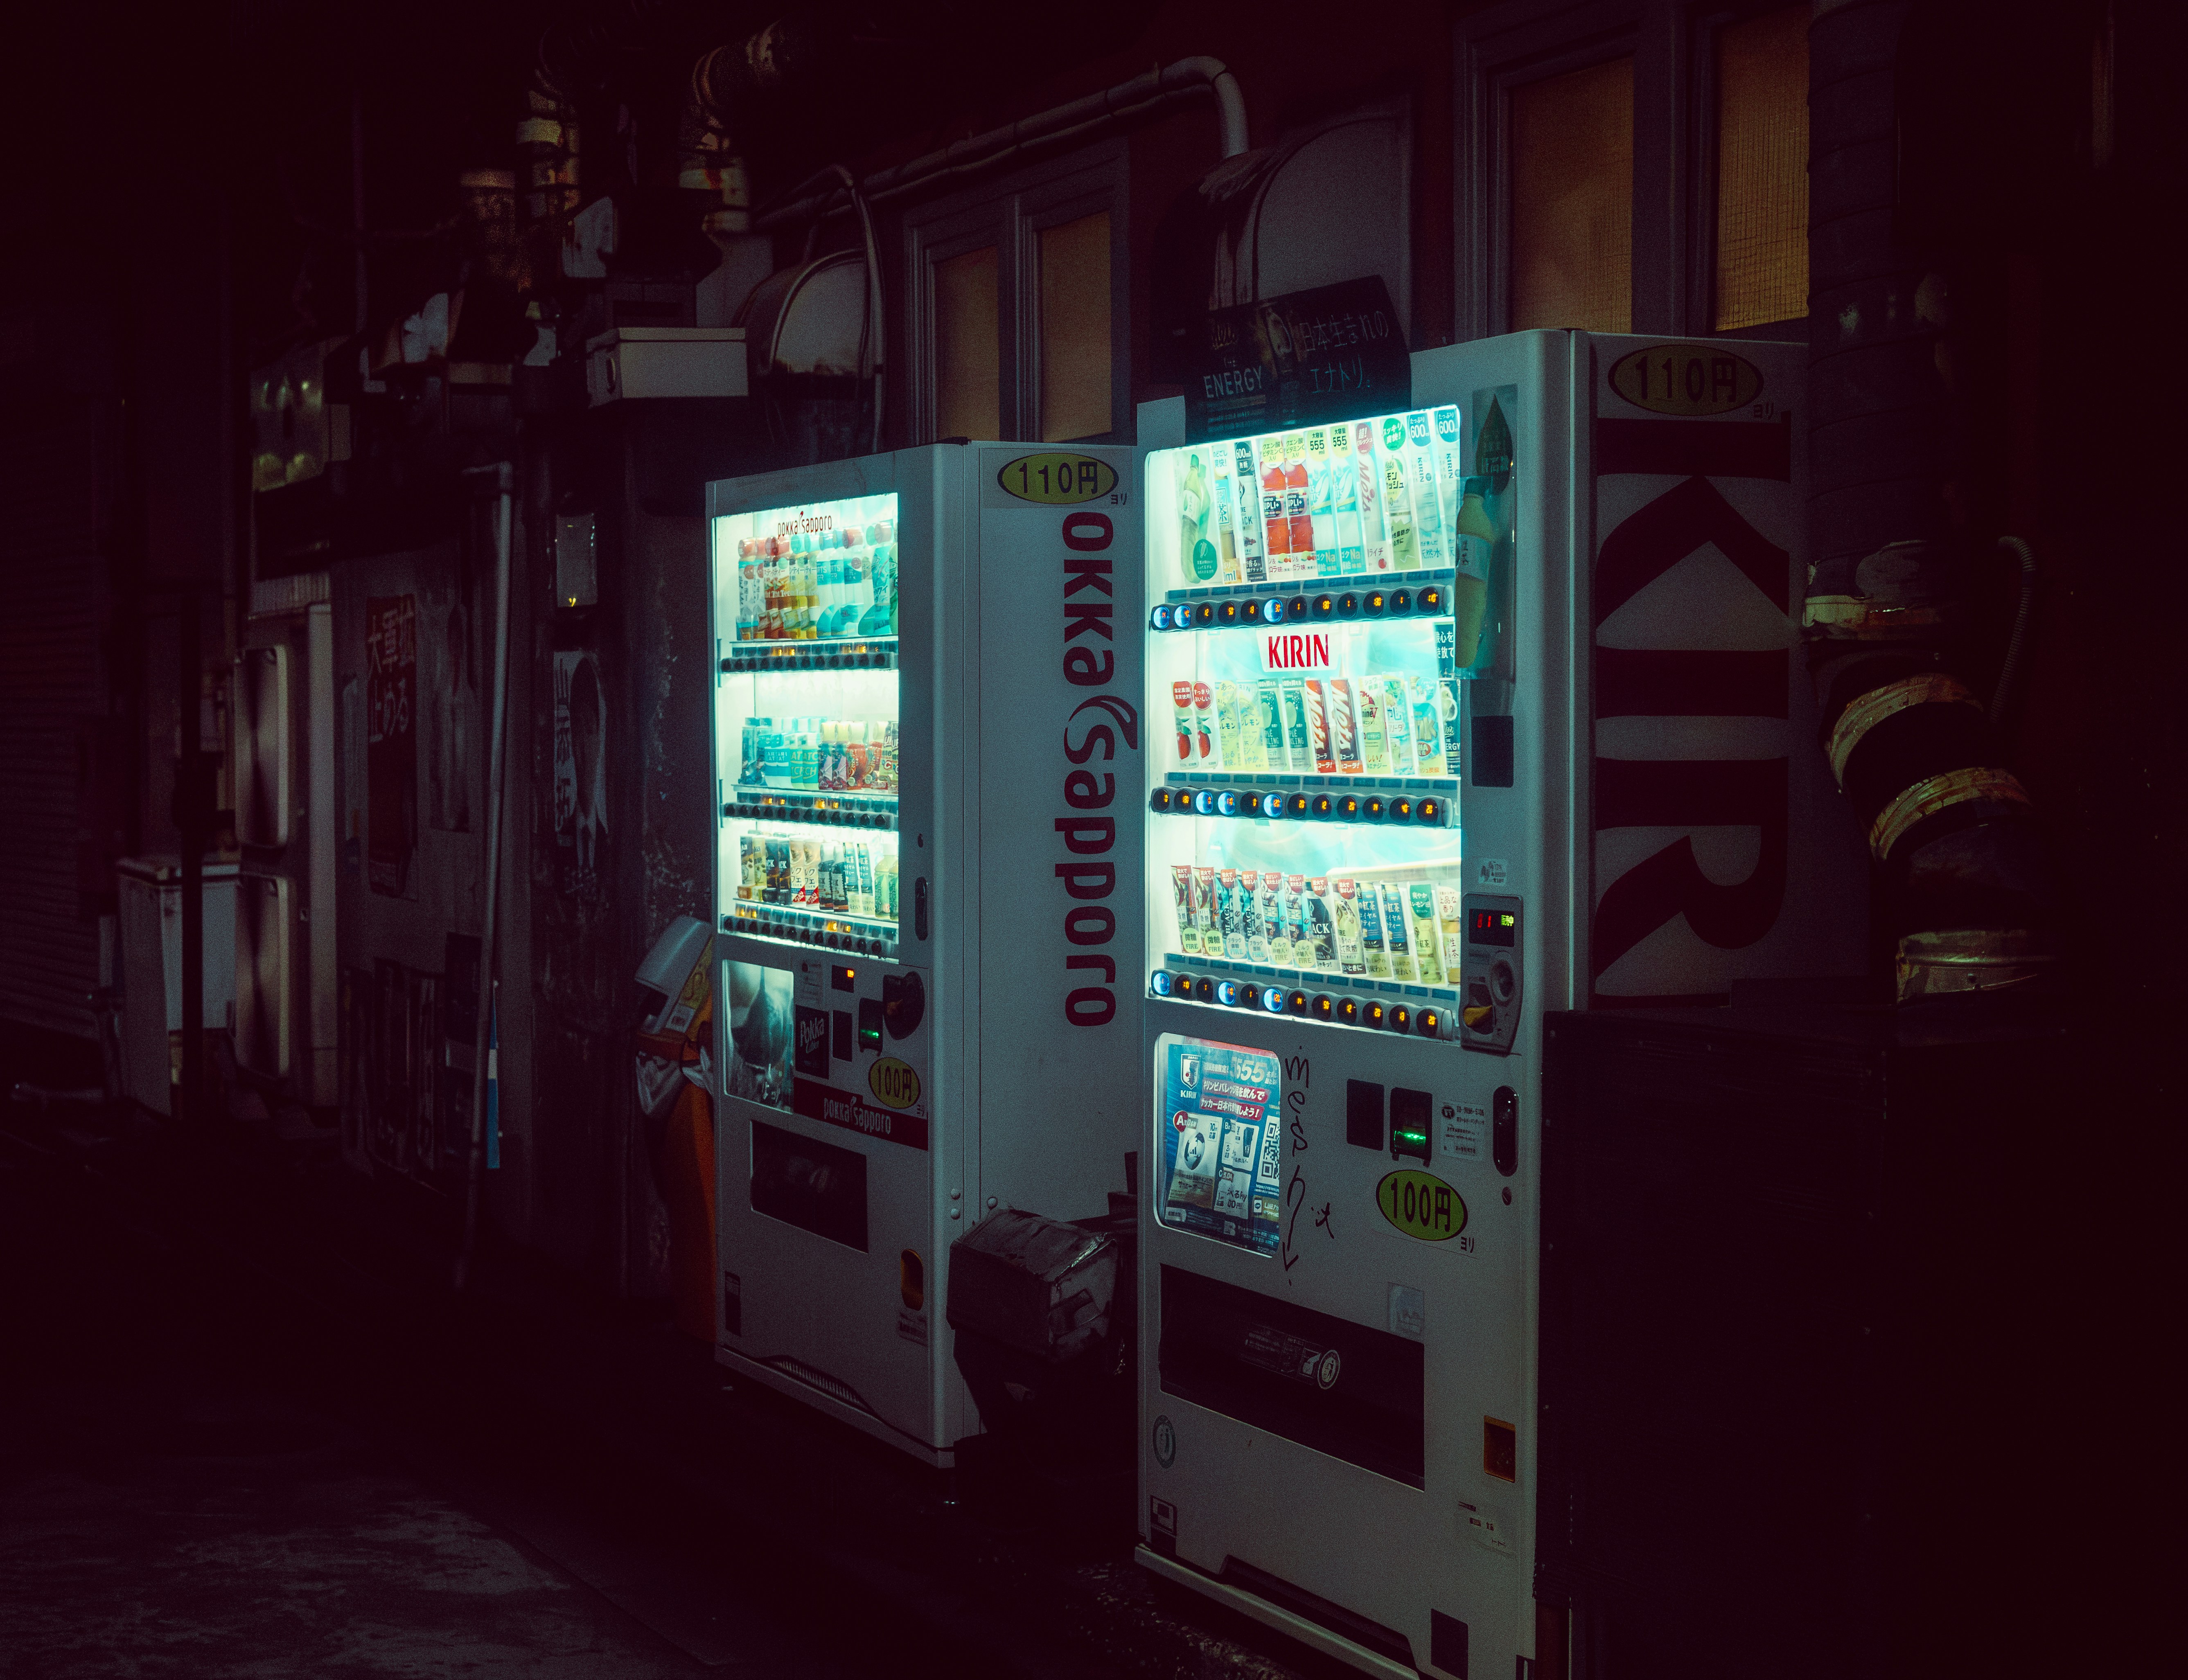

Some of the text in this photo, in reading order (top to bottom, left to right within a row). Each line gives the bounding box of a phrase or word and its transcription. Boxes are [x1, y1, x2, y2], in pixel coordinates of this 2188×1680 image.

[1203, 365, 1263, 399] ENERGY
[1635, 356, 1737, 403] 110円
[1236, 448, 1251, 459] 600ml
[1263, 441, 1281, 450] クエン酸
[1286, 438, 1303, 447] クエン酸
[1310, 439, 1324, 450] 555
[1333, 435, 1347, 447] 555
[1019, 461, 1098, 494] 110円
[1268, 634, 1329, 668] KIRIN
[1595, 410, 1791, 1010] KIR
[1055, 723, 1116, 1027] sapporo
[878, 1064, 912, 1103] 100円
[1390, 1177, 1451, 1232] 100円
